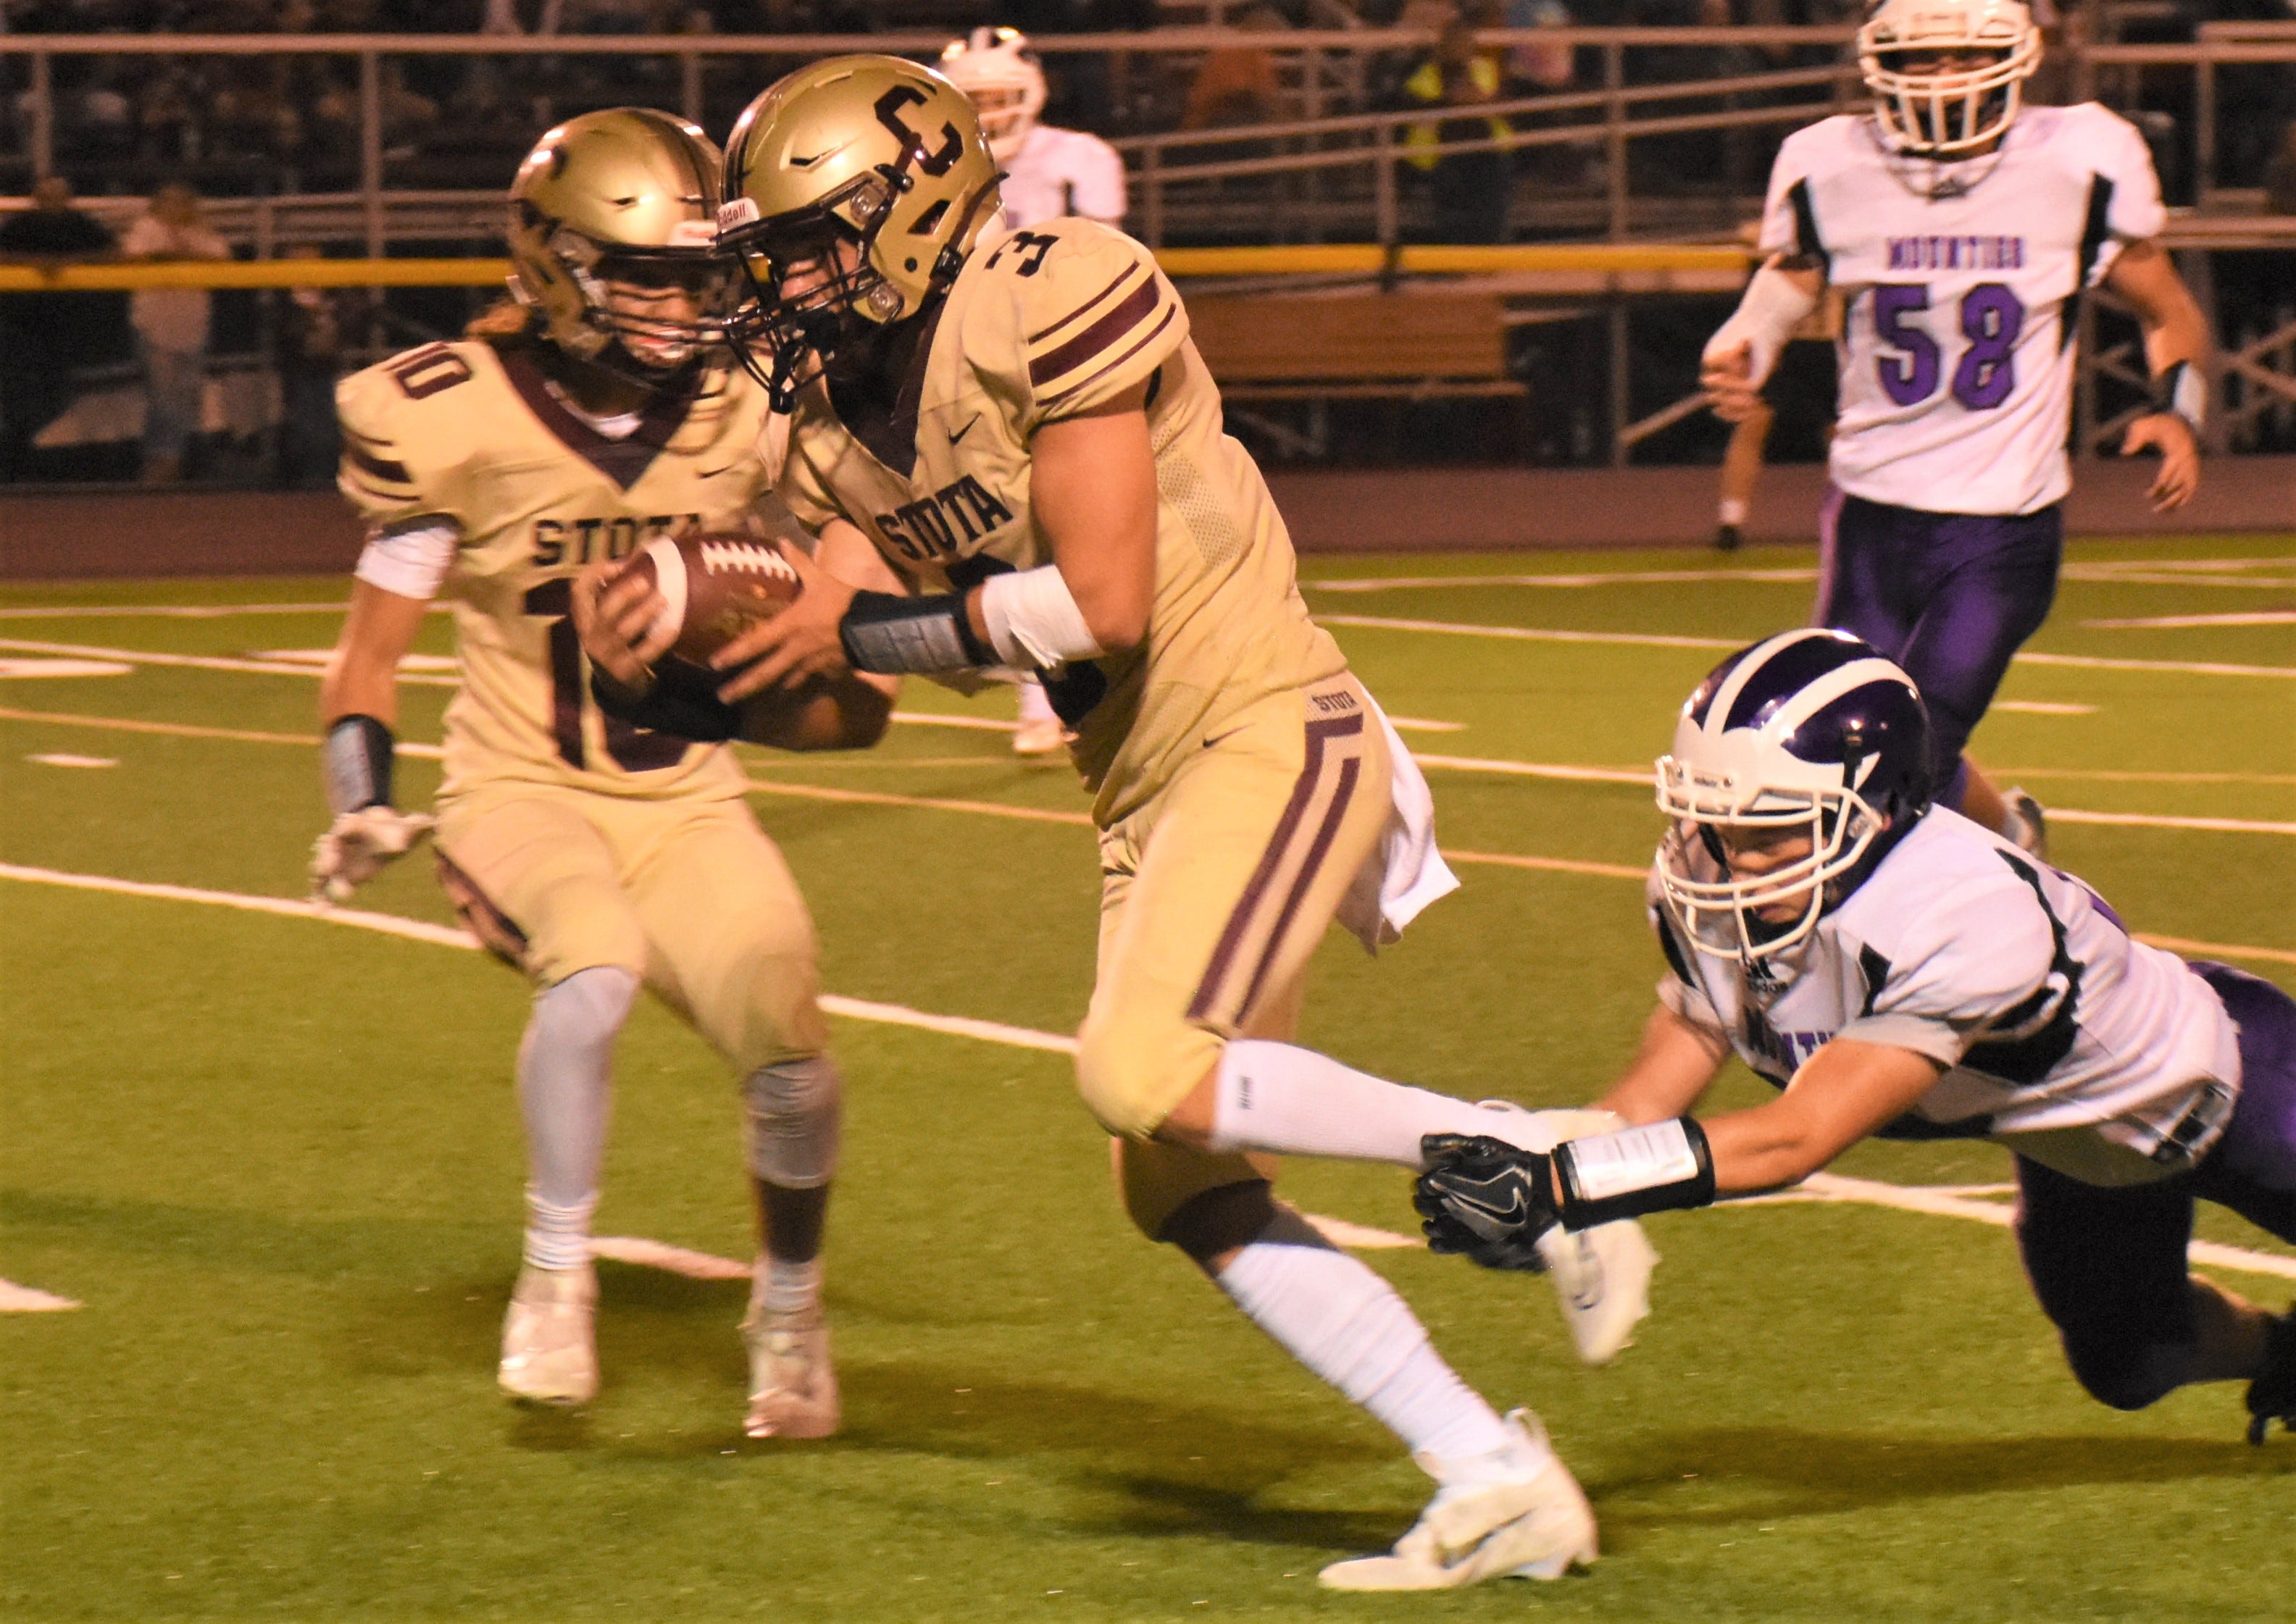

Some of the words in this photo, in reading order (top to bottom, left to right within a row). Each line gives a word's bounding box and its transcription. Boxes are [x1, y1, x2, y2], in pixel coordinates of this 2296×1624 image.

[985, 231, 1060, 277] 3
[383, 341, 473, 400] 10
[1874, 282, 2024, 411] 58
[532, 513, 700, 566] STOT
[875, 474, 1014, 561] STOTA
[1311, 690, 1358, 711] STOTA
